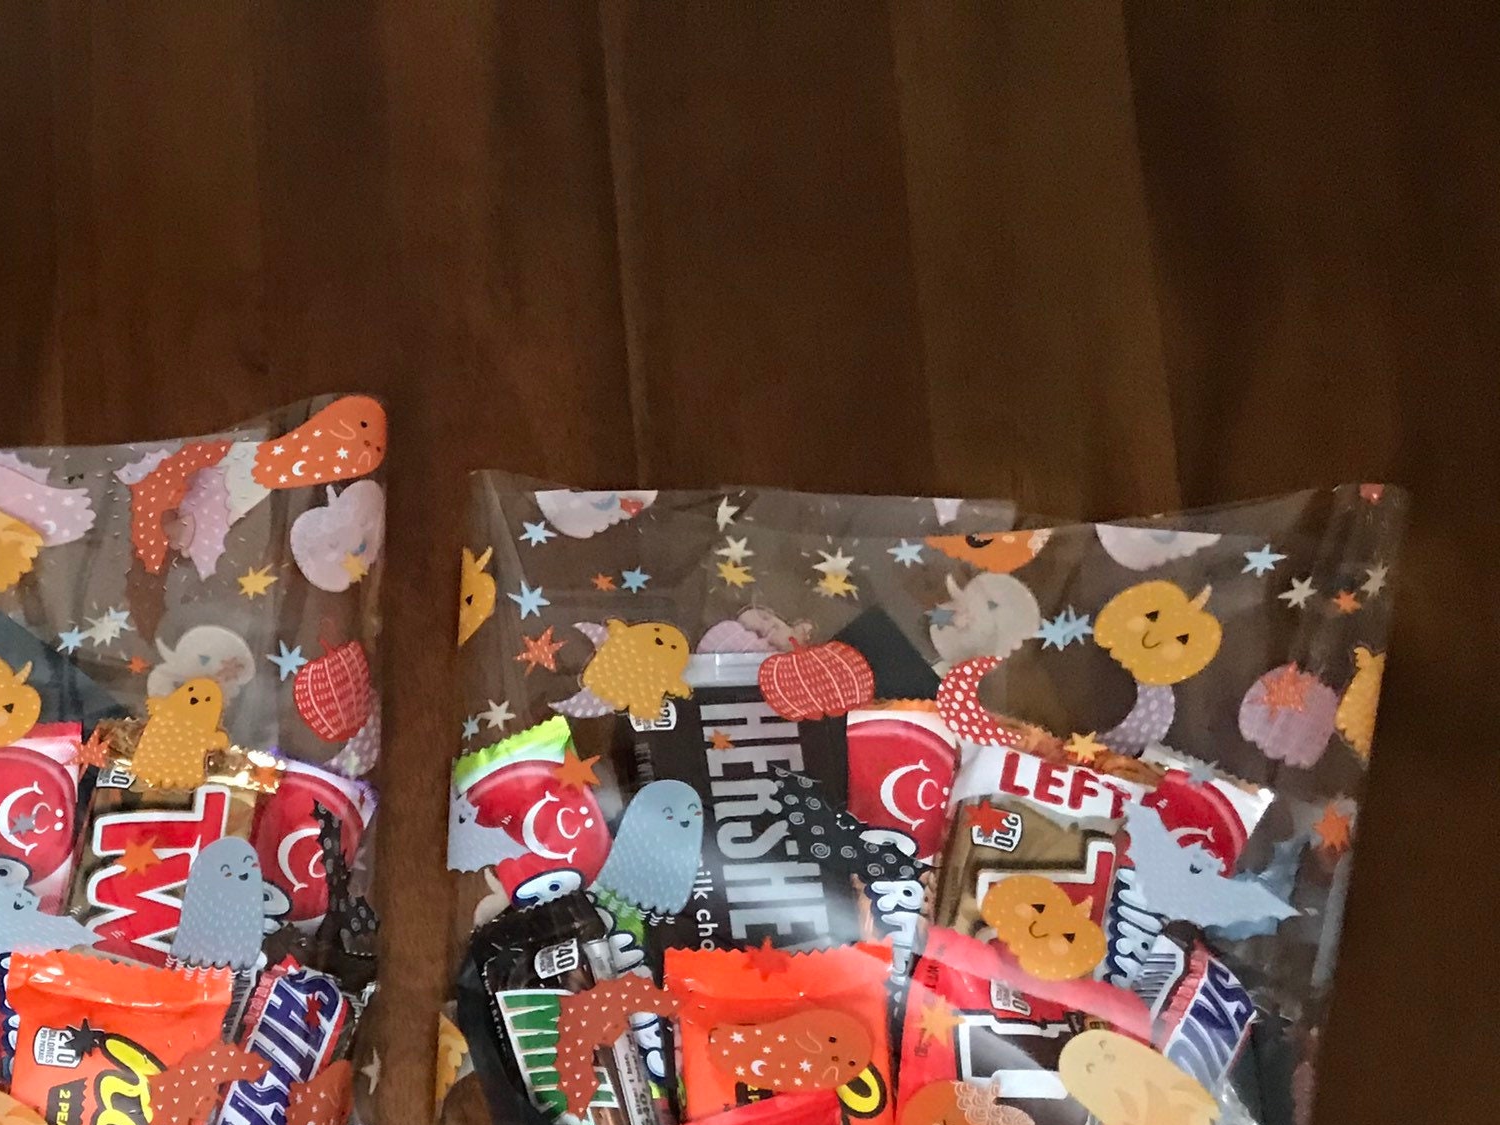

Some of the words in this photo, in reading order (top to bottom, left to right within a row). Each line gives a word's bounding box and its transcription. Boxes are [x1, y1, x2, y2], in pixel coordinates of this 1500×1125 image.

[1000, 750, 1131, 820] LEFT
[46, 1030, 56, 1063] CALORIES
[58, 1089, 71, 1098] 2
